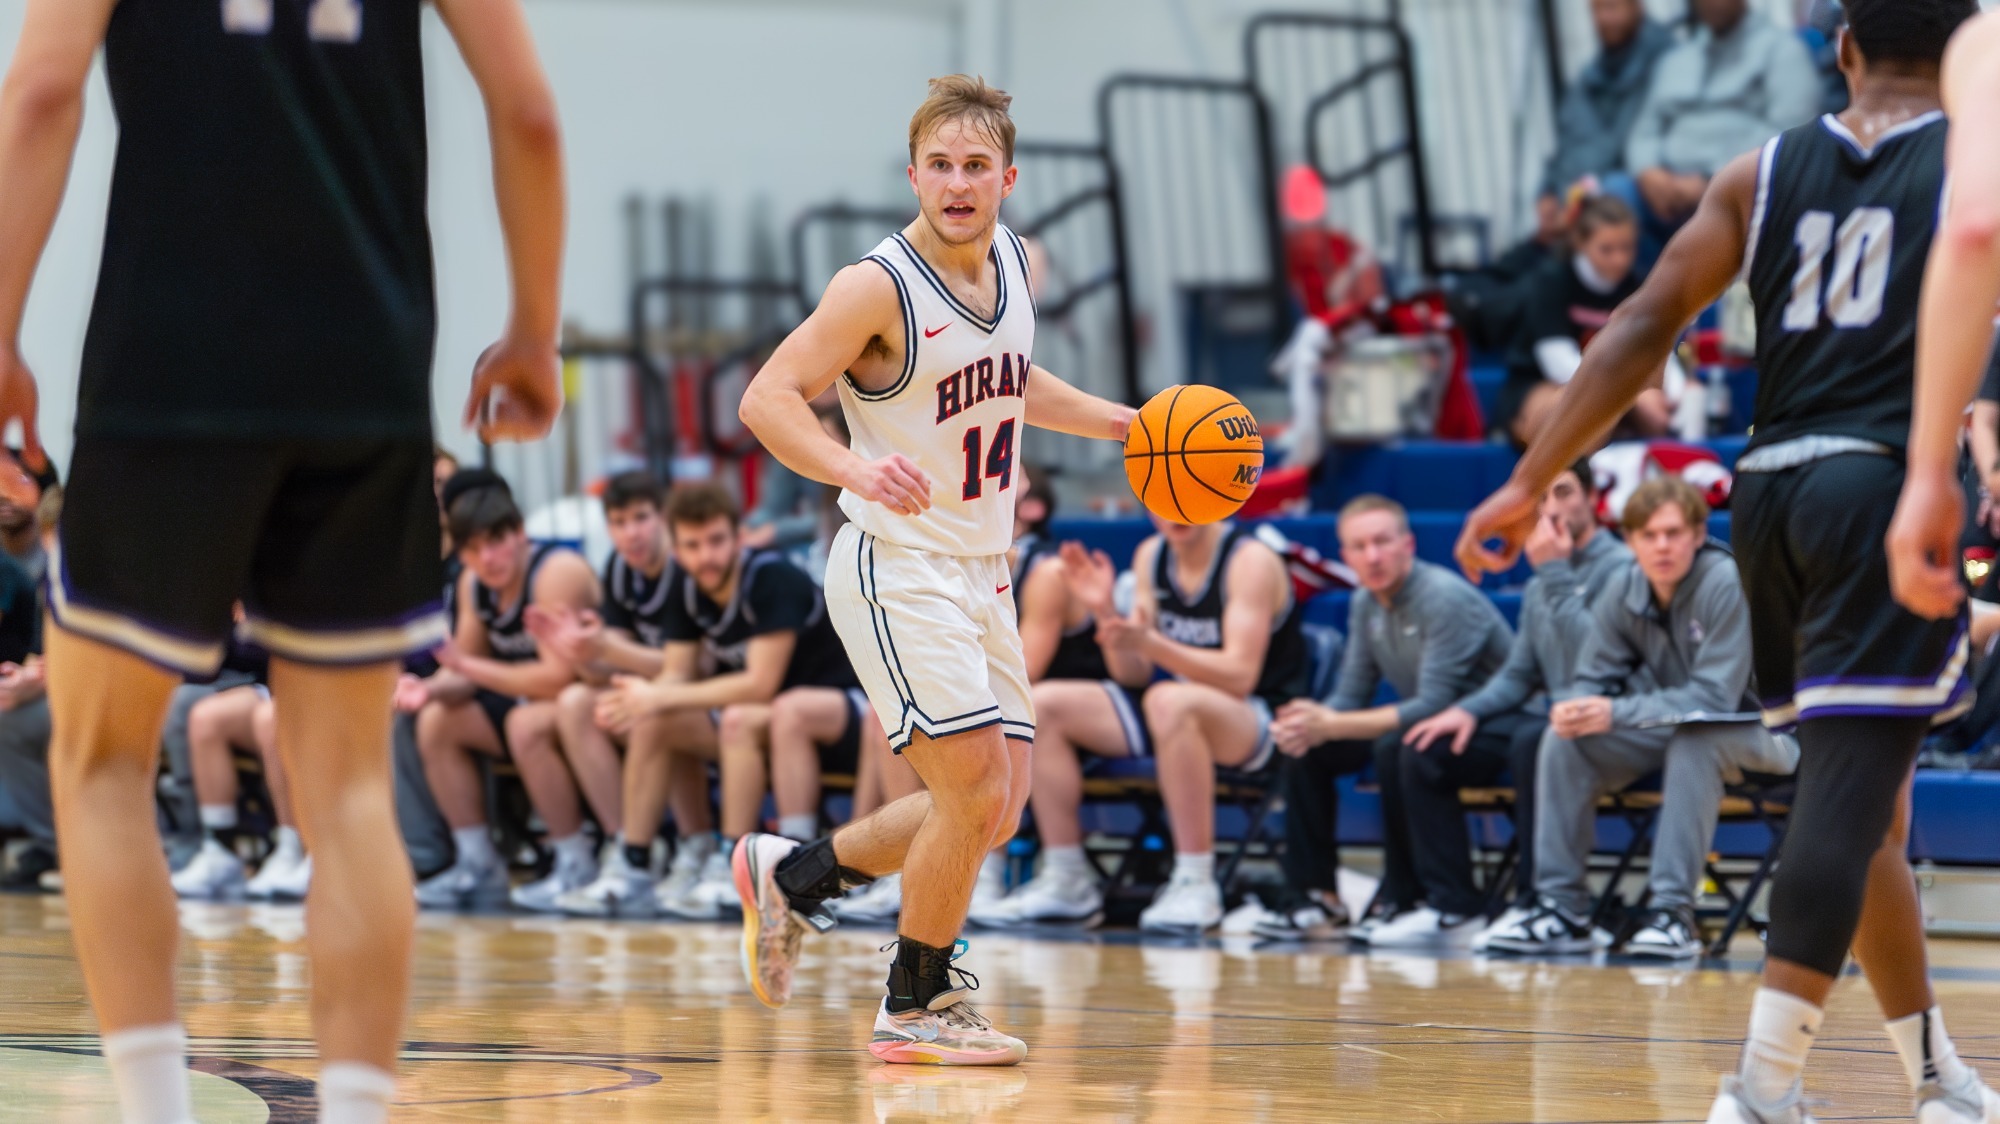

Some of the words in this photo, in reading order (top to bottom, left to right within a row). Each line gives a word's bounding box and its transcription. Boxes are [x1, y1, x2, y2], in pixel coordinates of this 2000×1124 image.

[1782, 207, 1894, 330] 10
[936, 353, 1030, 426] HIRAM
[962, 417, 1015, 502] 14
